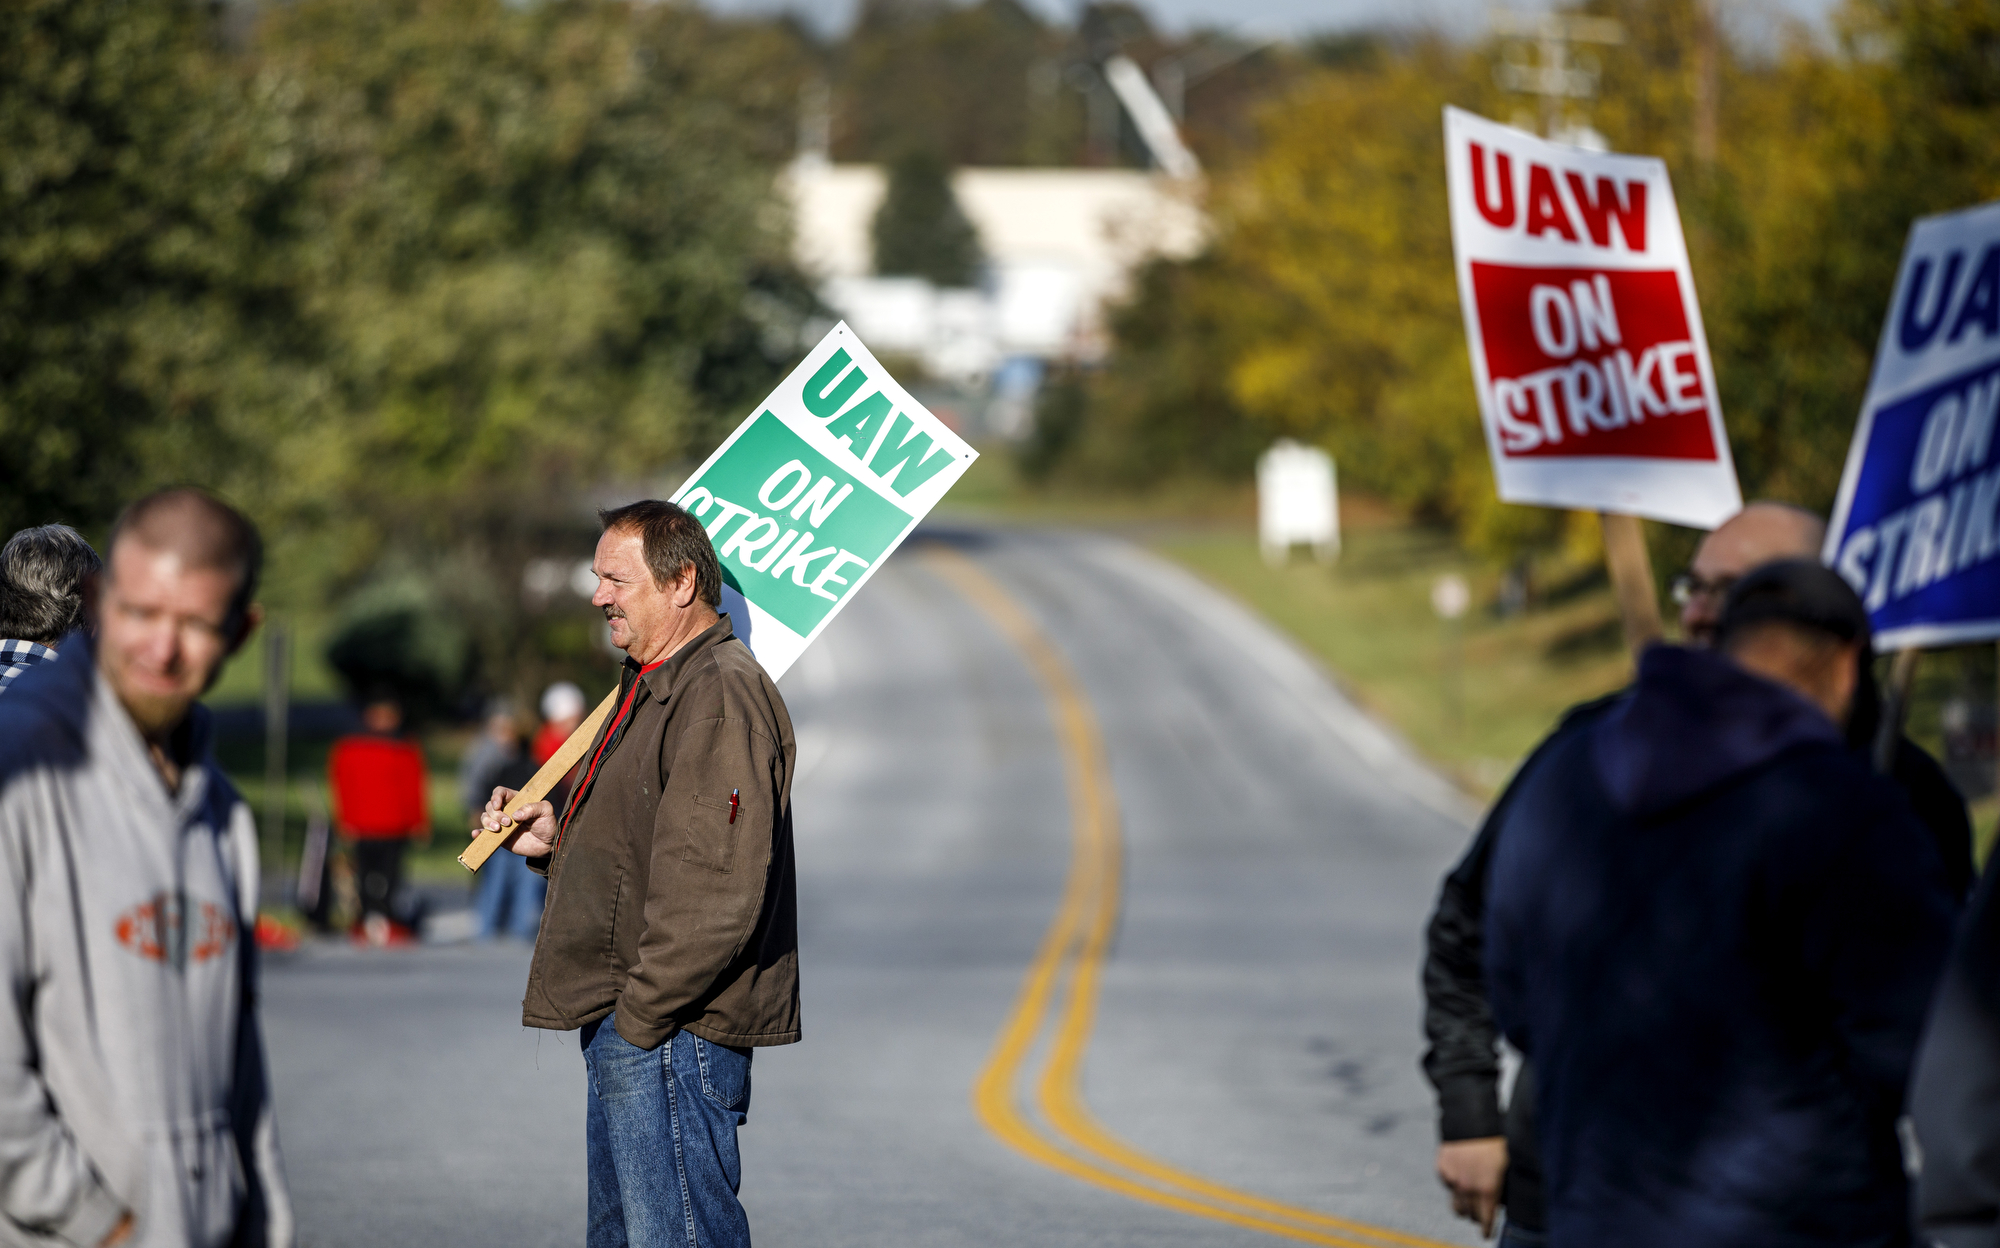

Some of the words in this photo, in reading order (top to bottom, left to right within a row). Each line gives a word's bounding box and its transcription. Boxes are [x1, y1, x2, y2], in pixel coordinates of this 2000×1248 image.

[1468, 140, 1648, 254] UAW
[1529, 272, 1622, 358] ON
[1900, 240, 2000, 354] UA
[802, 347, 956, 498] UAW
[1491, 340, 1709, 452] STRIKE
[1909, 371, 2000, 495] ON
[758, 459, 854, 529] ON
[1839, 462, 2000, 613] STRIK
